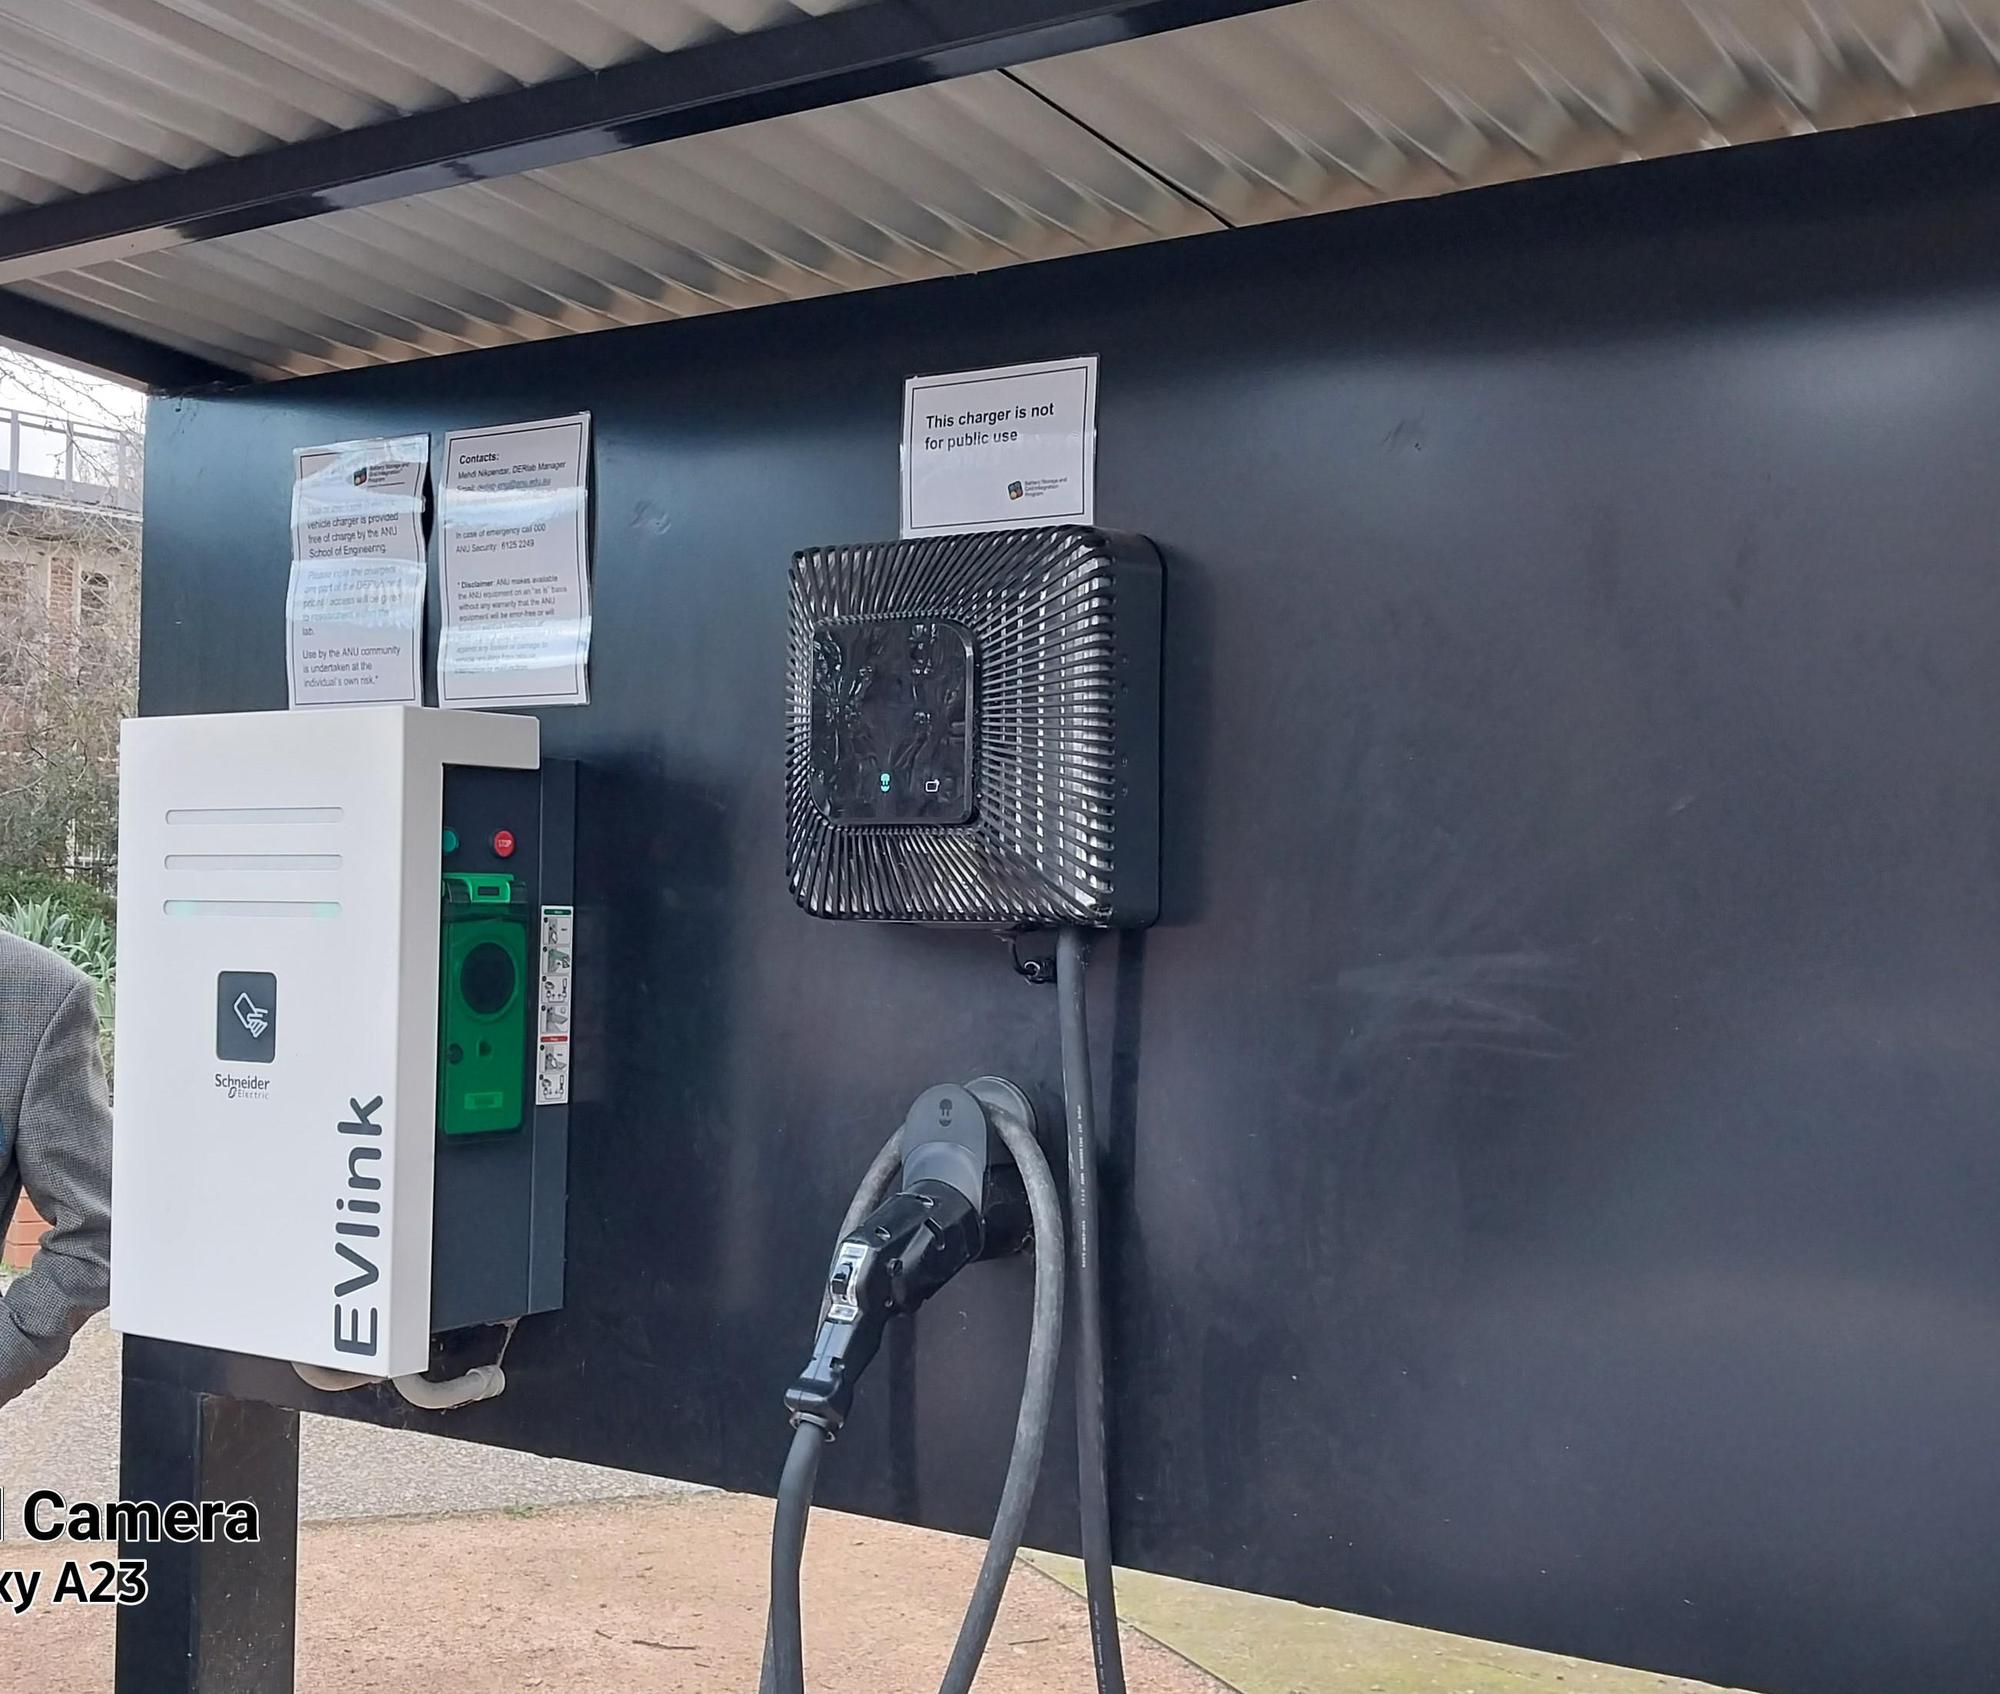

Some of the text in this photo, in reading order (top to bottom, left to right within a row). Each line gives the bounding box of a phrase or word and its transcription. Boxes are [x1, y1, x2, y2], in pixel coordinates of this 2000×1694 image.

[926, 403, 1055, 429] This charger is not
[925, 430, 1018, 451] for public use
[459, 453, 499, 464] Contacts:
[458, 471, 476, 479] Mehdi
[538, 461, 566, 471] Manager
[307, 512, 399, 529] vehicle charger is provided
[308, 526, 397, 544] free of charge by the ANU
[463, 531, 477, 539] case
[479, 529, 485, 537] of
[486, 527, 520, 536] emergency
[521, 525, 532, 533] call
[534, 523, 546, 532] 000
[309, 547, 333, 558] School
[335, 546, 342, 555] of
[456, 545, 470, 553] ANU
[501, 541, 518, 550] 6125
[483, 590, 513, 598] equipment
[481, 603, 490, 611] any
[492, 600, 516, 609] warranty
[541, 597, 555, 605] ANU
[509, 610, 536, 618] error-free
[303, 646, 400, 660] Use by the ANU community
[304, 661, 373, 673] is undertaken at the
[344, 678, 359, 686] own
[215, 1073, 270, 1090] Schneider
[238, 1089, 270, 1099] Electric
[334, 1095, 383, 1357] EVlink
